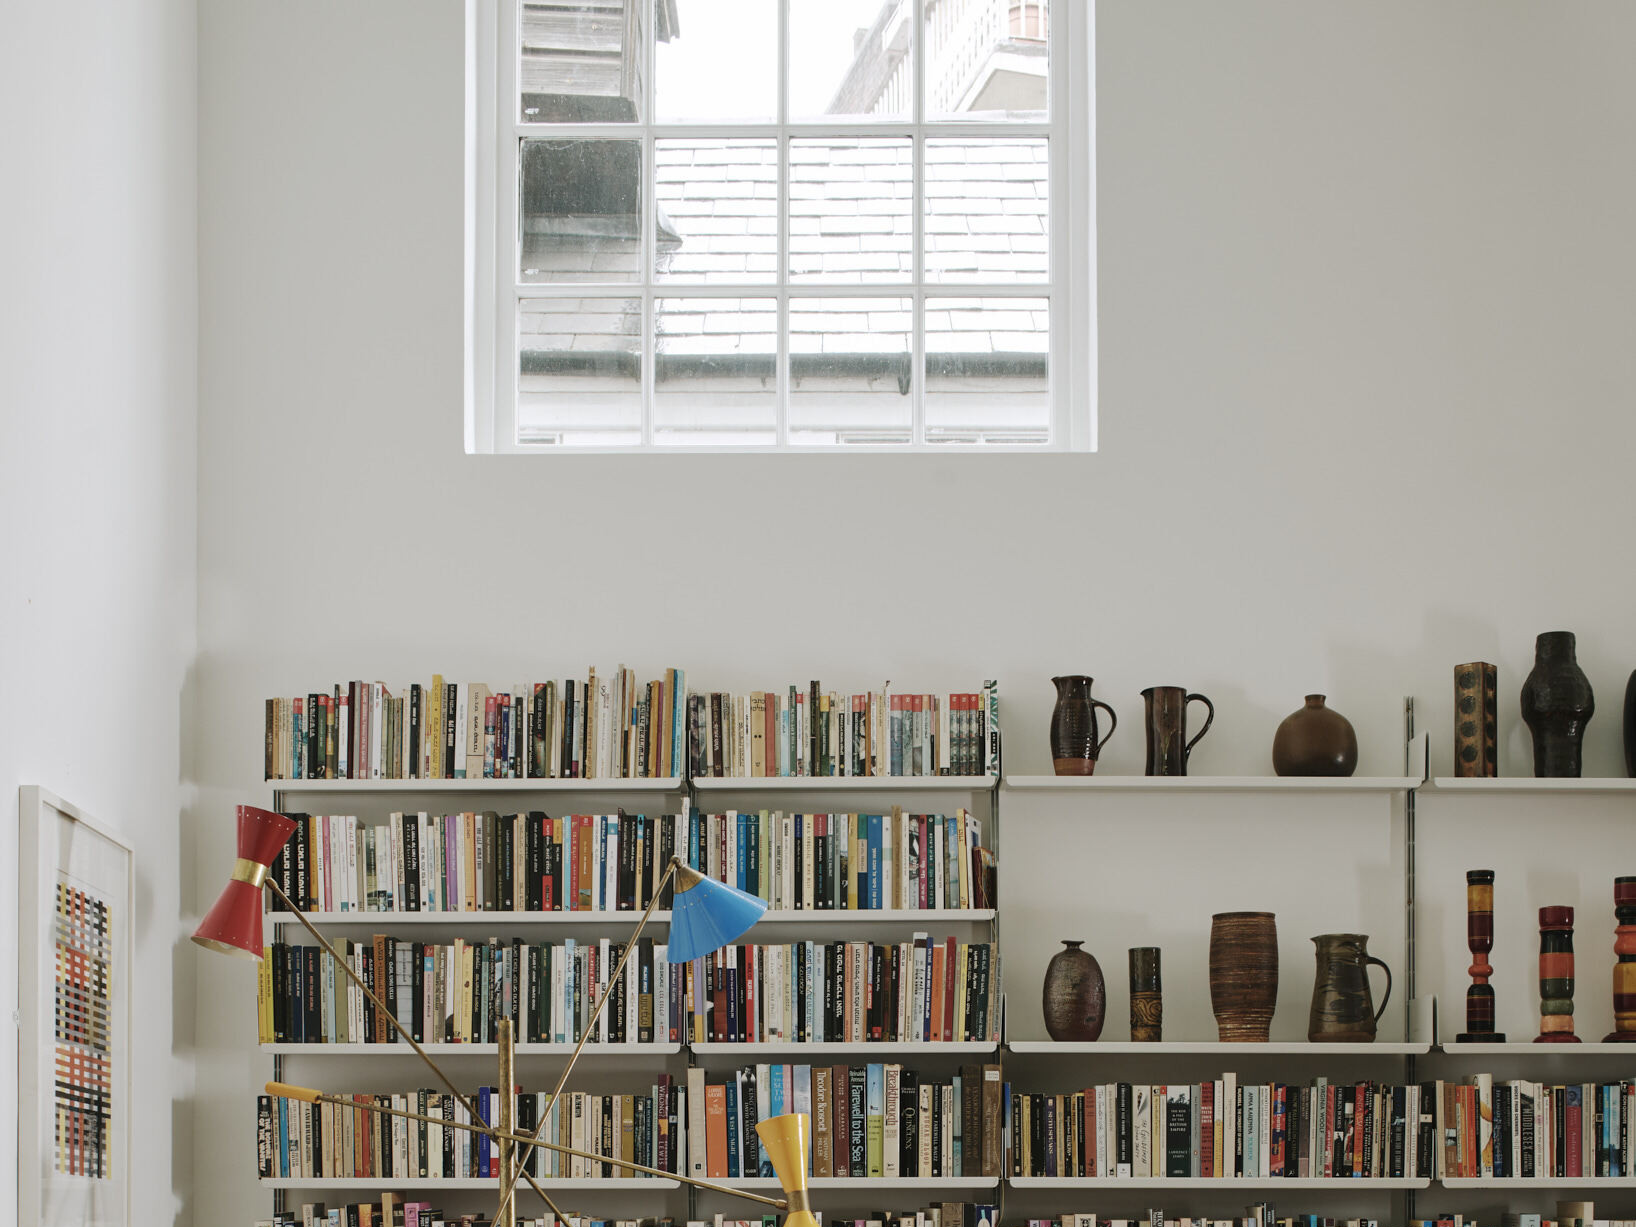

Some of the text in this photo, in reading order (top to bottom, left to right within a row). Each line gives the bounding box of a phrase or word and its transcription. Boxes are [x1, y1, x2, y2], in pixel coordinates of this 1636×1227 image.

[851, 1085, 864, 1162] Farewell to the Sea
[885, 1069, 899, 1127] Breakthrough
